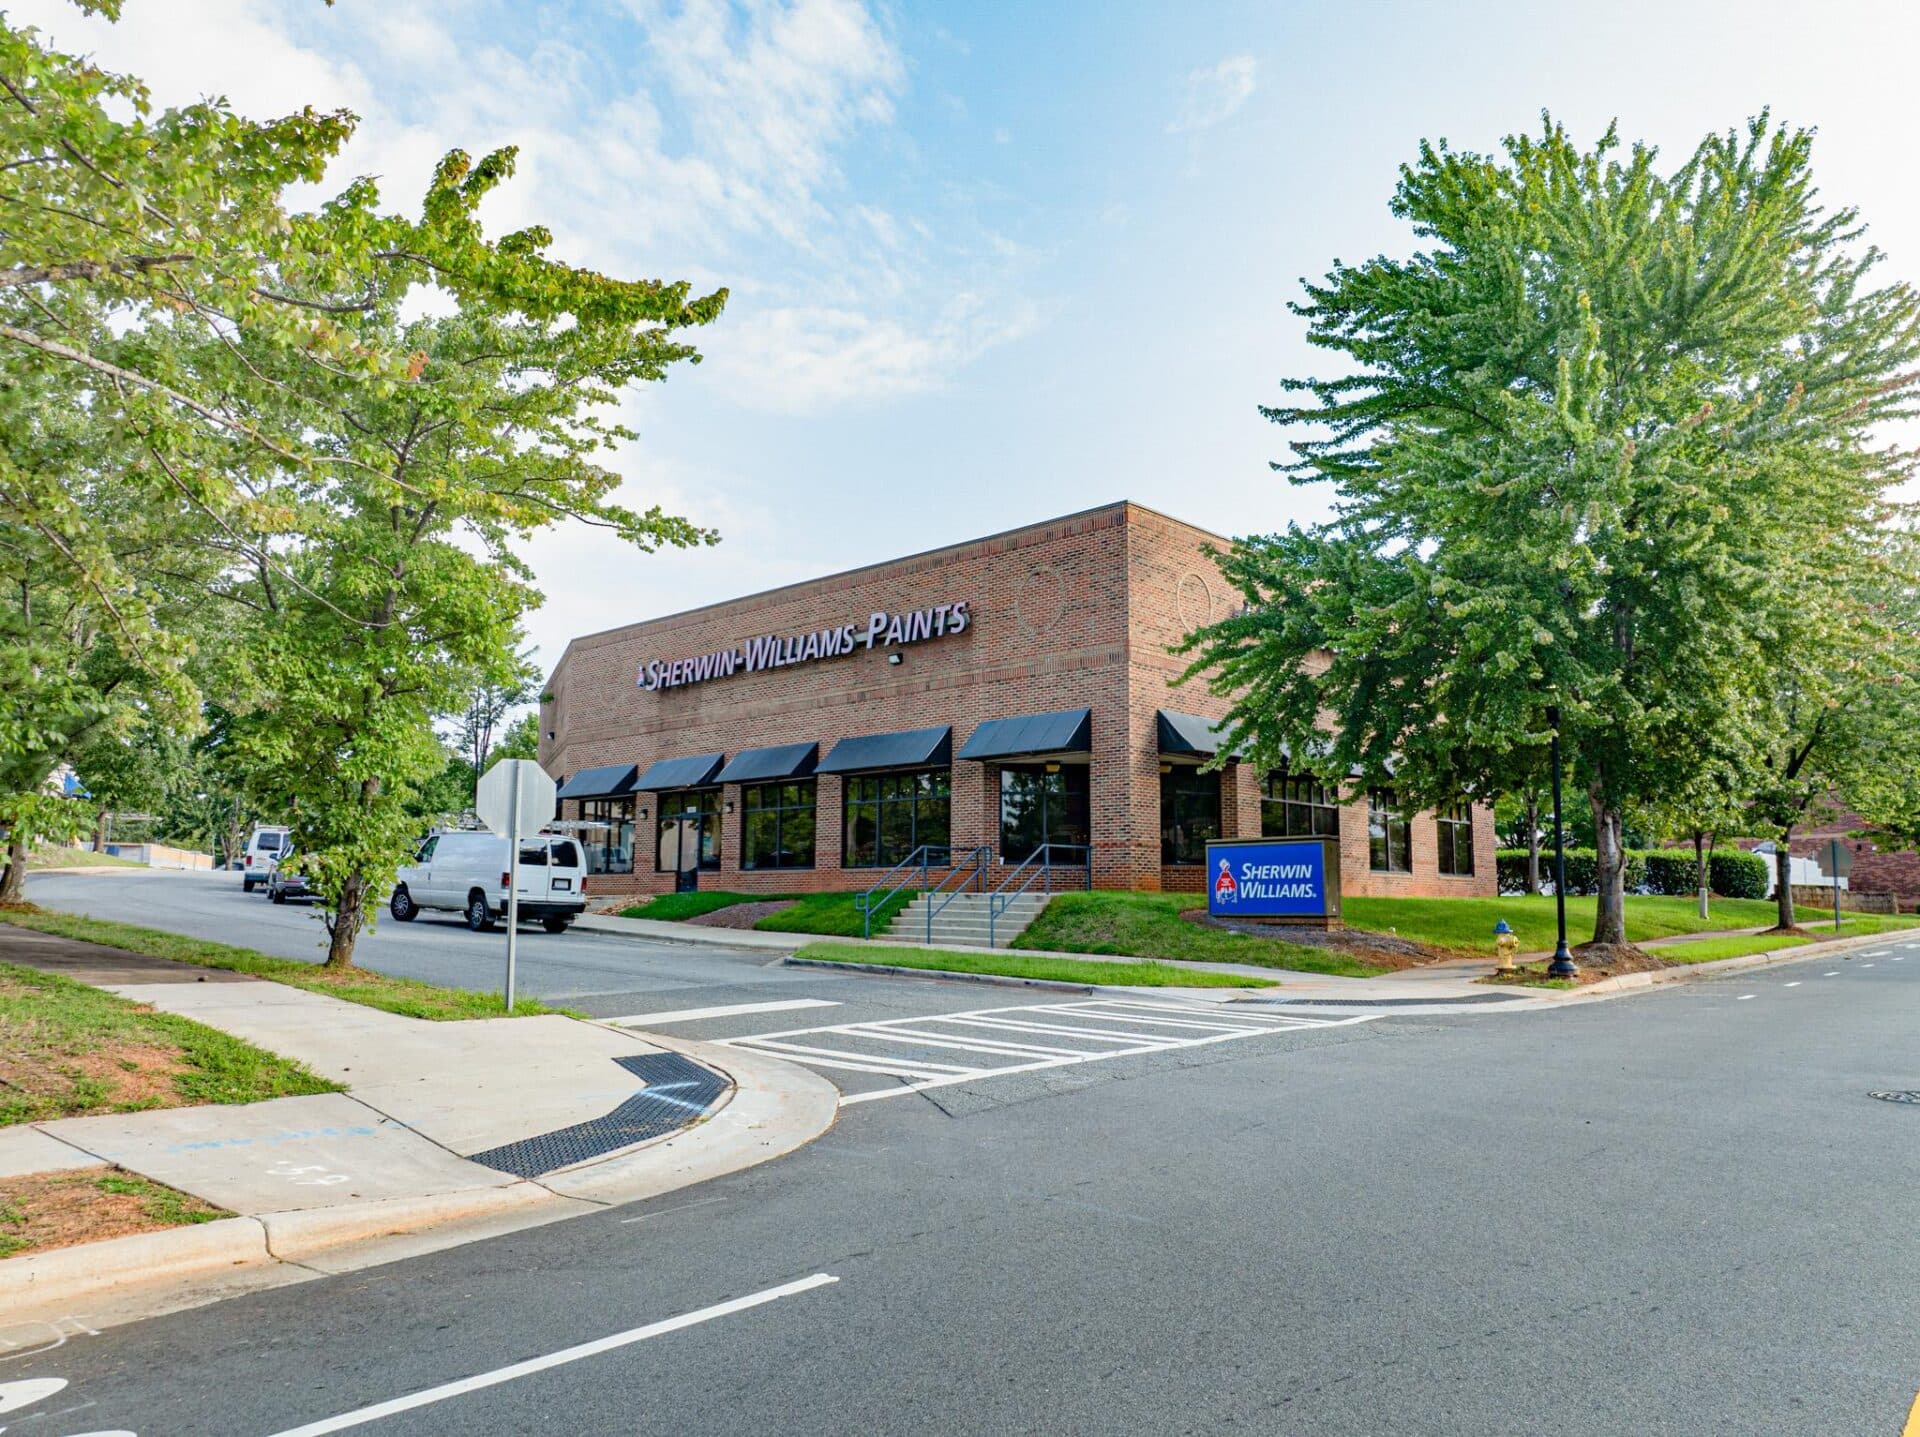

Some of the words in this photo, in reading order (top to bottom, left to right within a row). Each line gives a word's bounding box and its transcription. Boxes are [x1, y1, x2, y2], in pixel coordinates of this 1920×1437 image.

[645, 625, 856, 691] SHERWIN-WILLIAMS
[866, 602, 967, 649] PAINTS
[1241, 863, 1312, 880] SHERWIN
